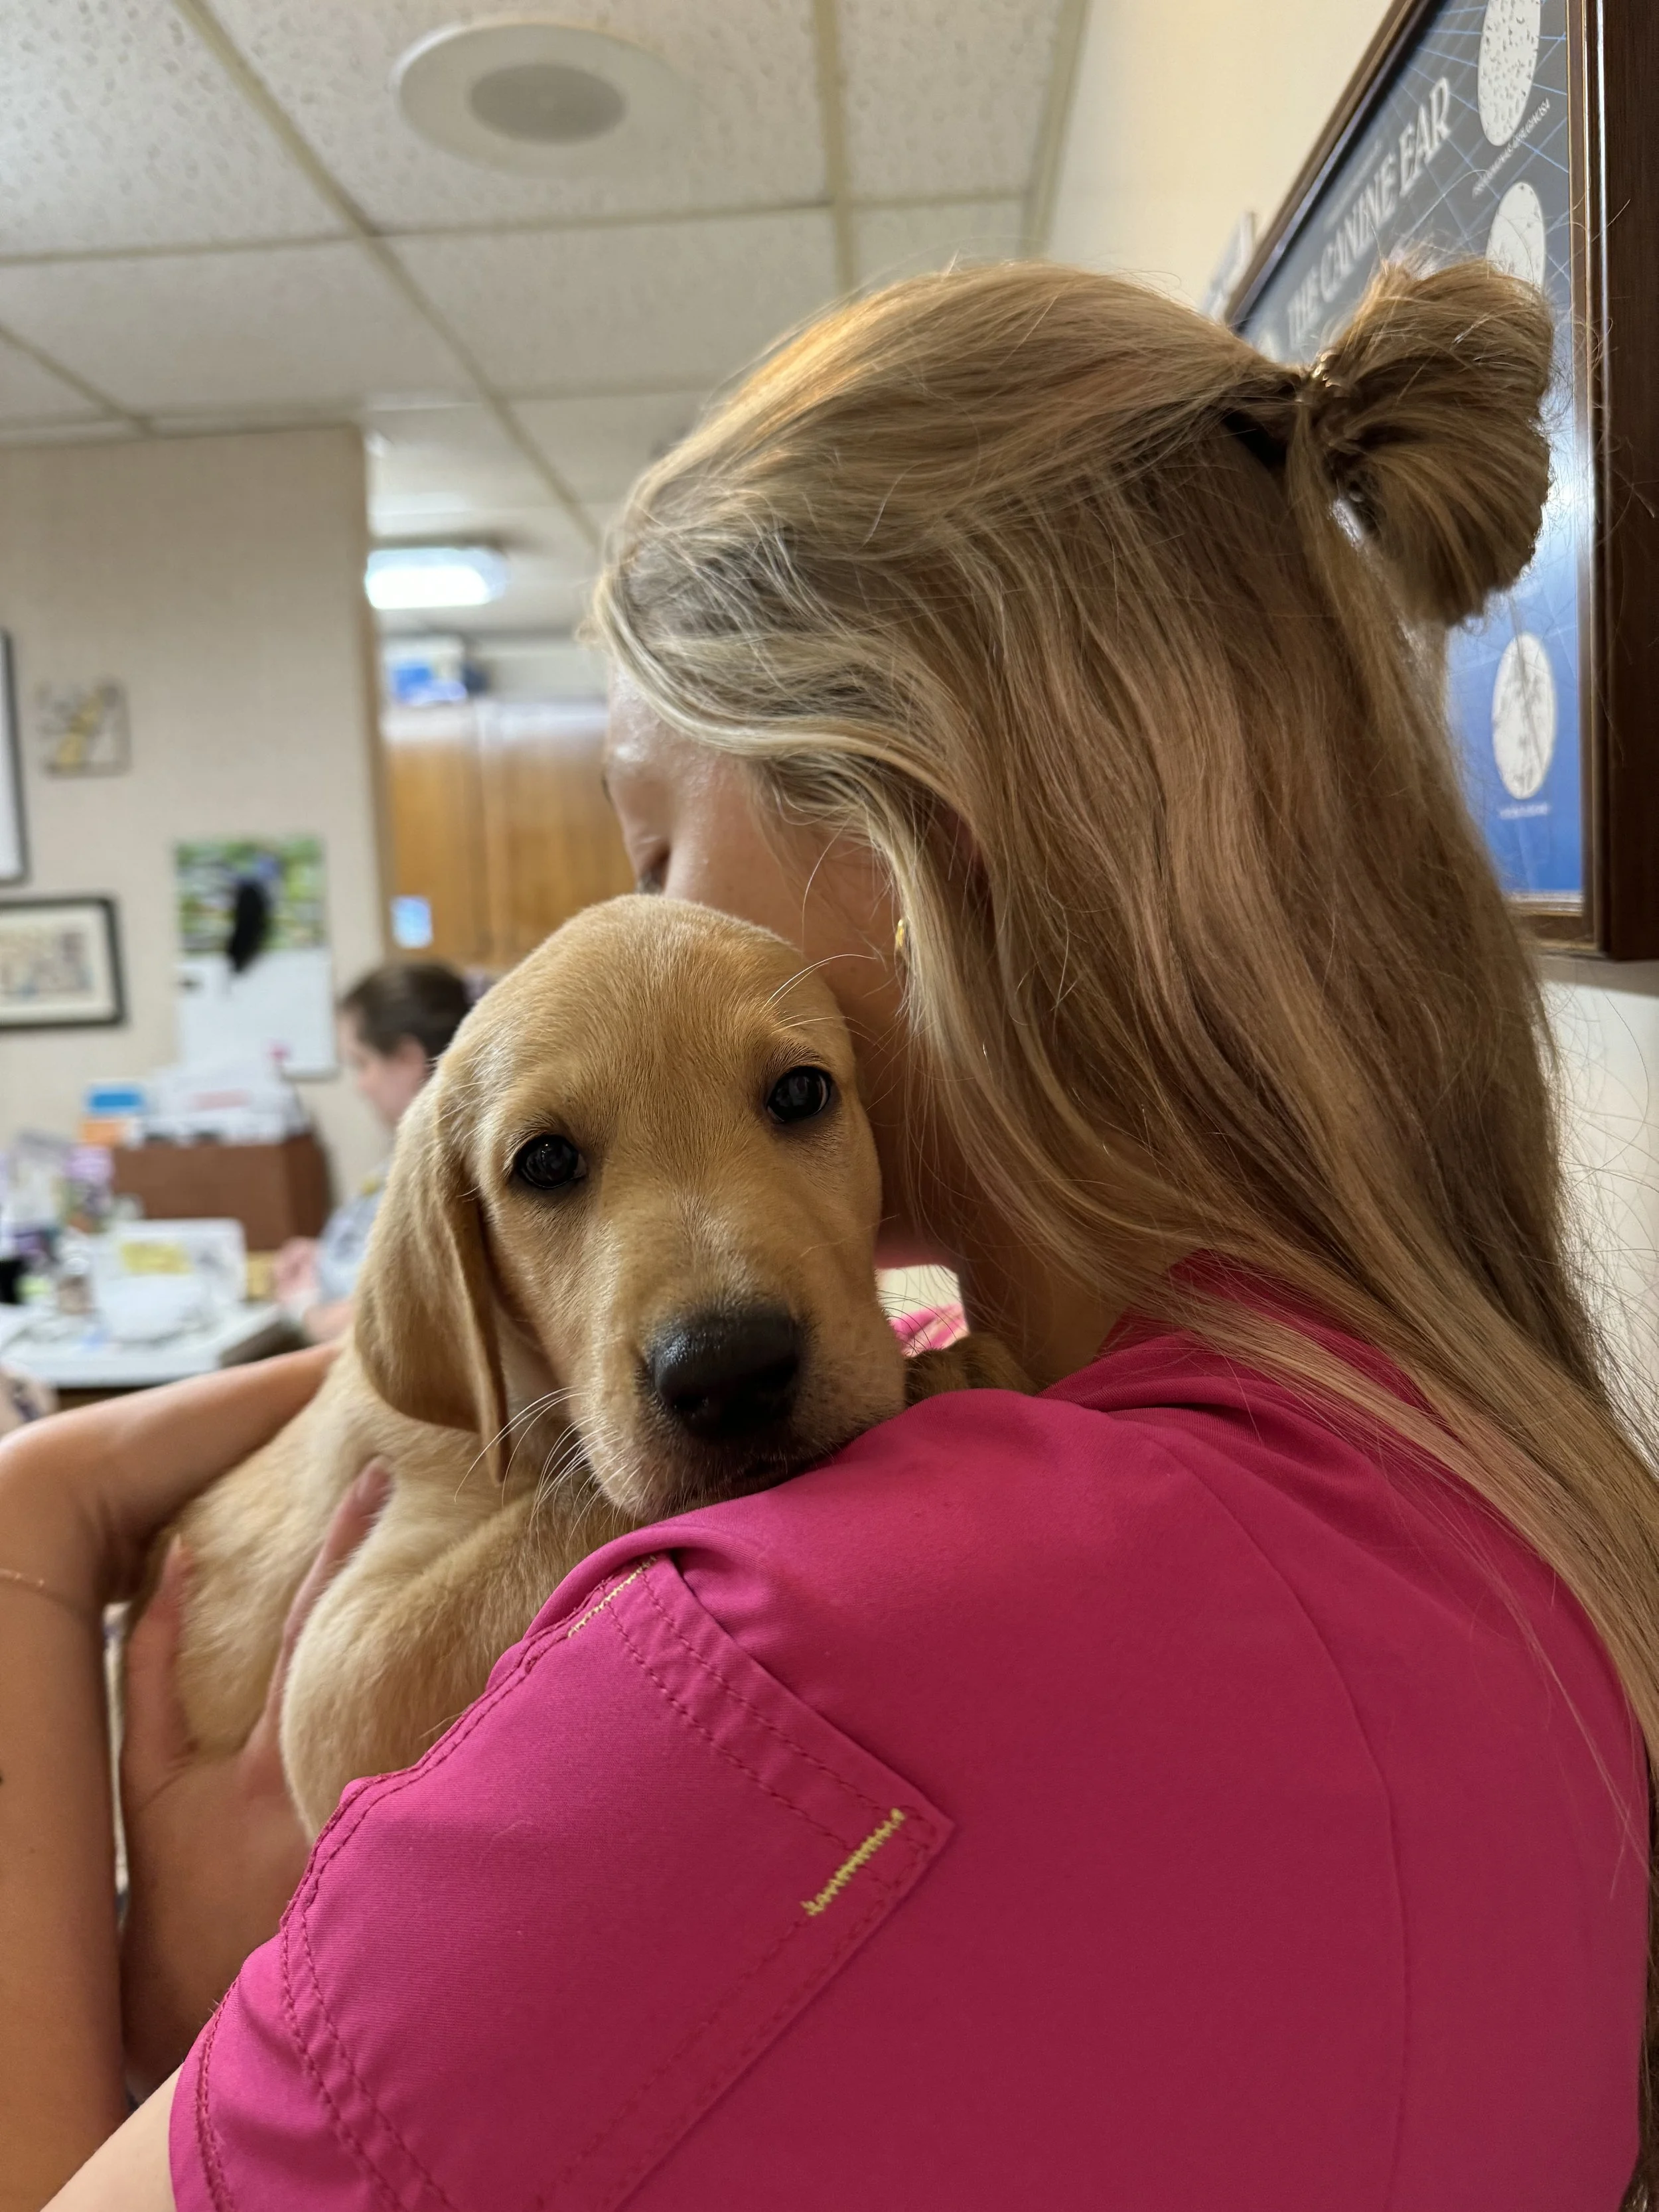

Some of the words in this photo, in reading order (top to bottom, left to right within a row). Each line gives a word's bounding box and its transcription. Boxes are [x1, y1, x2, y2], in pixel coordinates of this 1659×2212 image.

[1287, 265, 1321, 350] THE
[1320, 153, 1396, 303] CANINE
[1399, 76, 1451, 197] EAR
